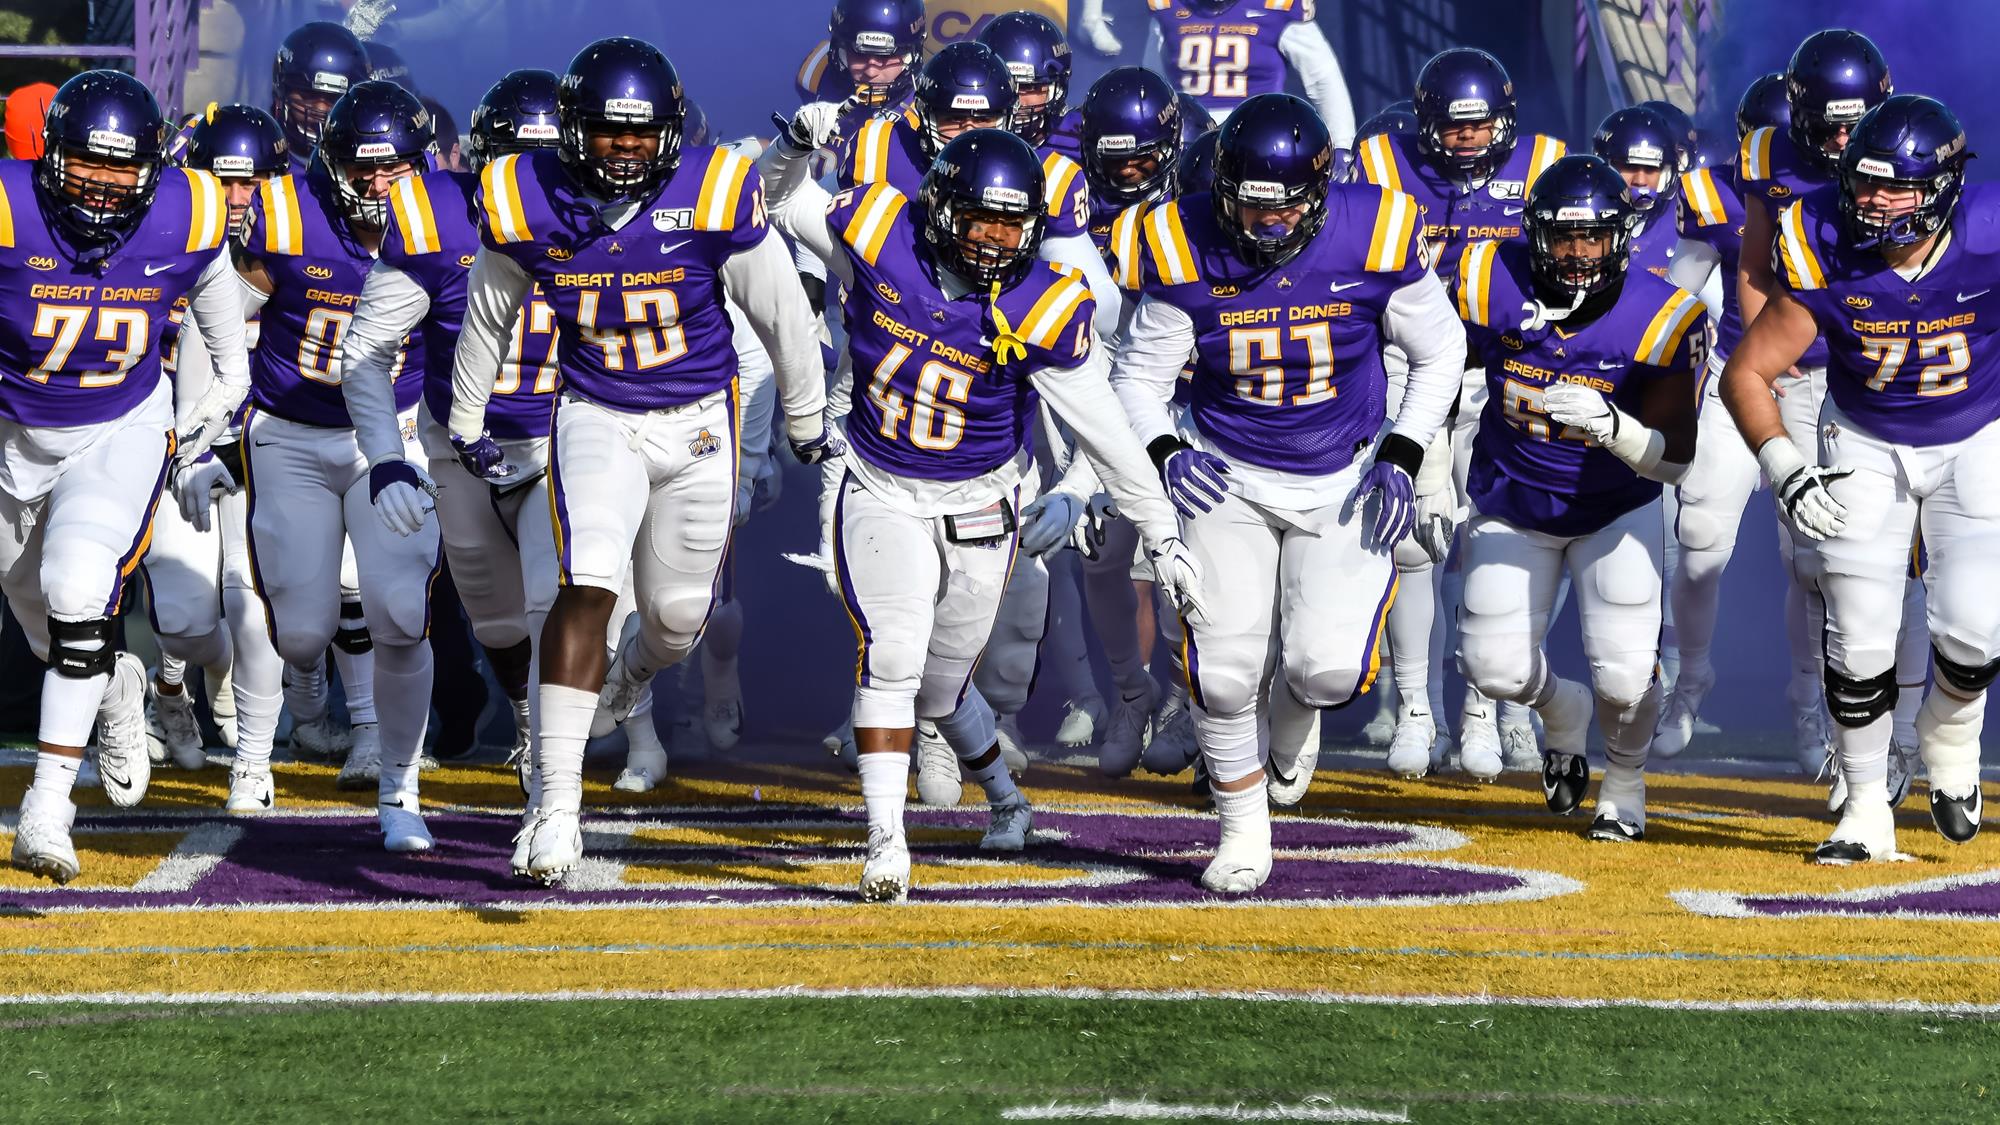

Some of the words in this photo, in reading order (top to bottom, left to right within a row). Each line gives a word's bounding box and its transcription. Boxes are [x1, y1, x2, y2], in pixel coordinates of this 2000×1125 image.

[1178, 25, 1214, 34] GREAT
[1219, 25, 1258, 36] DANES
[1178, 35, 1249, 97] 92
[615, 101, 642, 110] Riddell
[954, 97, 985, 105] Riddell
[361, 146, 390, 155] Riddell
[1250, 184, 1276, 193] Riddell
[1467, 226, 1520, 238] DANES
[29, 256, 54, 268] CAA
[548, 248, 569, 258] CAA
[306, 265, 329, 277] CAA
[554, 273, 614, 287] GREAT
[621, 267, 685, 287] DANES
[30, 283, 95, 300] GREAT
[101, 287, 162, 302] DANES
[877, 283, 899, 302] CAA
[1212, 285, 1236, 294] CAA
[1846, 296, 1869, 307] CAA
[1219, 307, 1281, 326] GREAT
[1289, 303, 1352, 320] DANES
[1852, 319, 1911, 334] GREAT
[1916, 312, 1976, 334] DANES
[577, 288, 689, 371] 40
[25, 303, 150, 388] 73
[872, 310, 928, 347] GREAT
[930, 340, 992, 374] DANES
[1229, 321, 1337, 406] 51
[1861, 331, 1971, 397] 72
[1503, 359, 1554, 381] GREAT
[1558, 373, 1614, 393] DANES
[868, 342, 974, 451] 46
